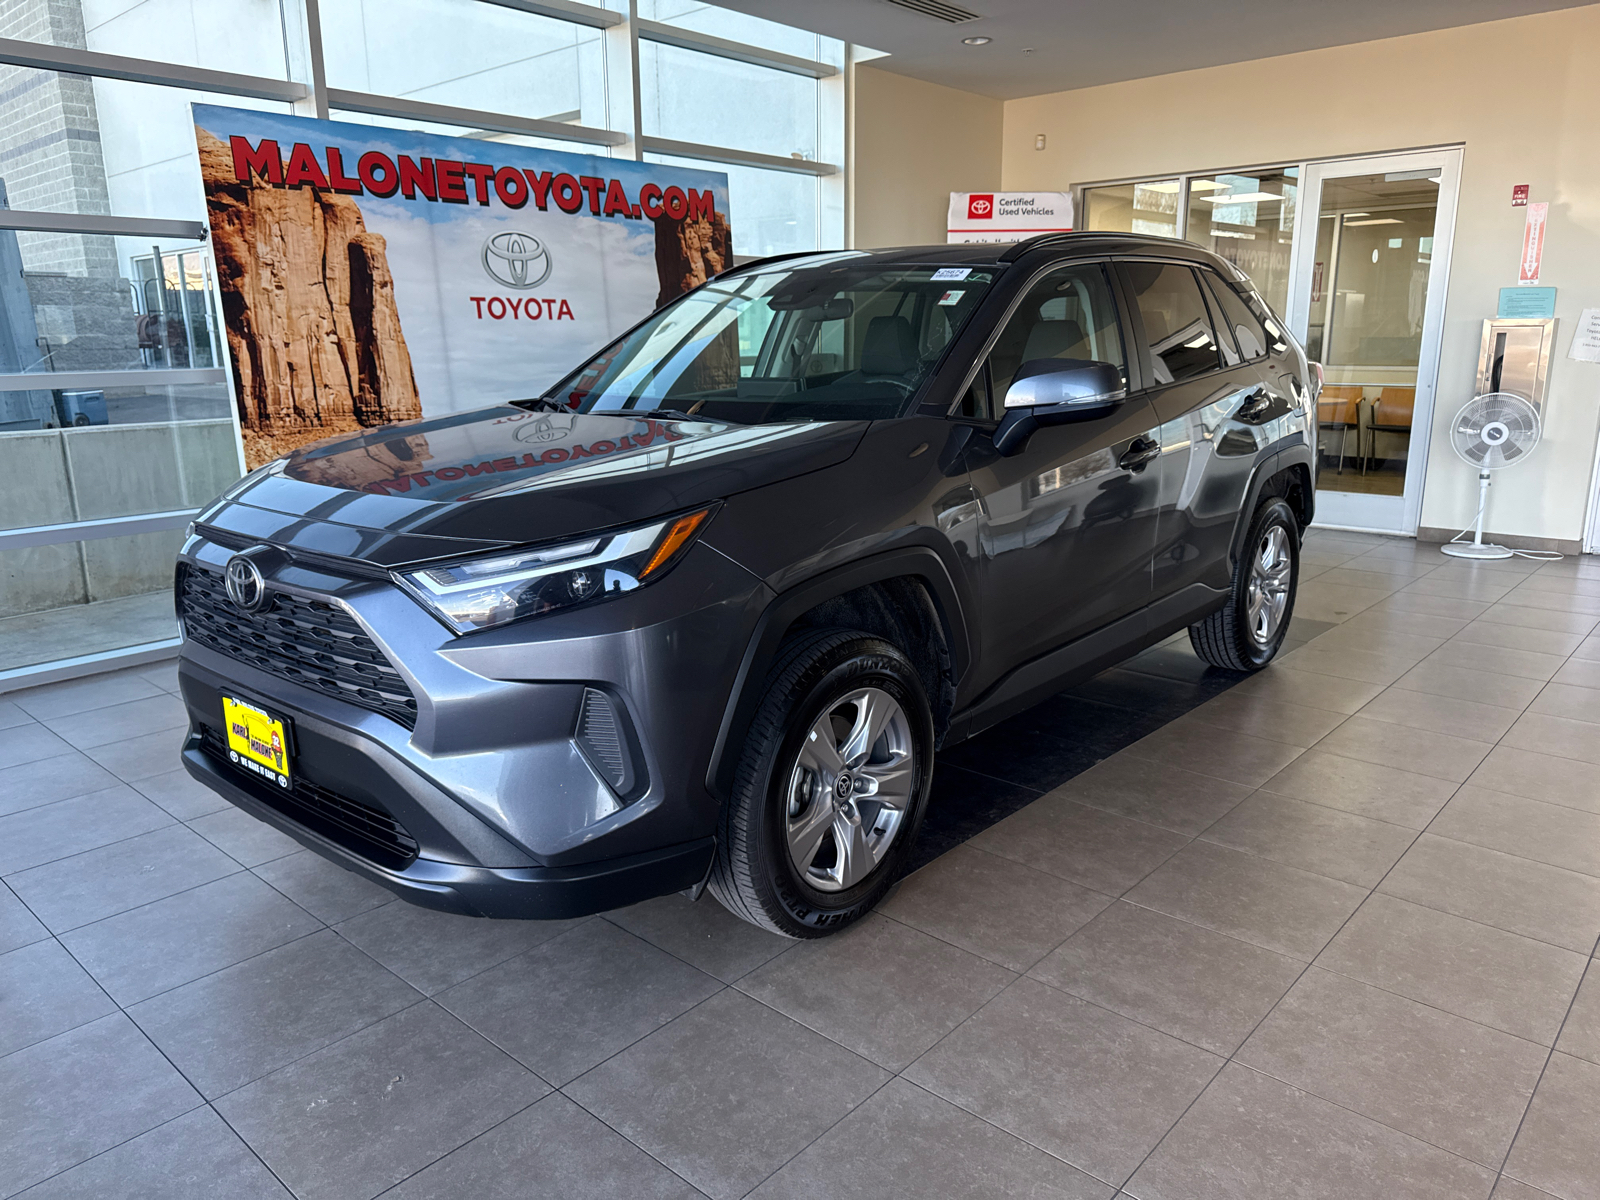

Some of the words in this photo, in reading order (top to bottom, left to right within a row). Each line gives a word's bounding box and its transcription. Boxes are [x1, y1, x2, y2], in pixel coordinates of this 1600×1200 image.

[229, 134, 715, 223] MALONETOYOTA.COM
[999, 198, 1035, 206] Certified
[999, 208, 1020, 216] Used
[1021, 208, 1054, 216] Vehicles
[1527, 218, 1539, 273] EXTINGUISHER
[470, 296, 575, 322] TOYOTA
[846, 656, 911, 678] DUNLOP
[232, 722, 248, 740] KARL
[250, 738, 273, 760] MALONE
[240, 756, 248, 767] WE
[248, 759, 260, 773] MAKE
[264, 768, 276, 781] EASY
